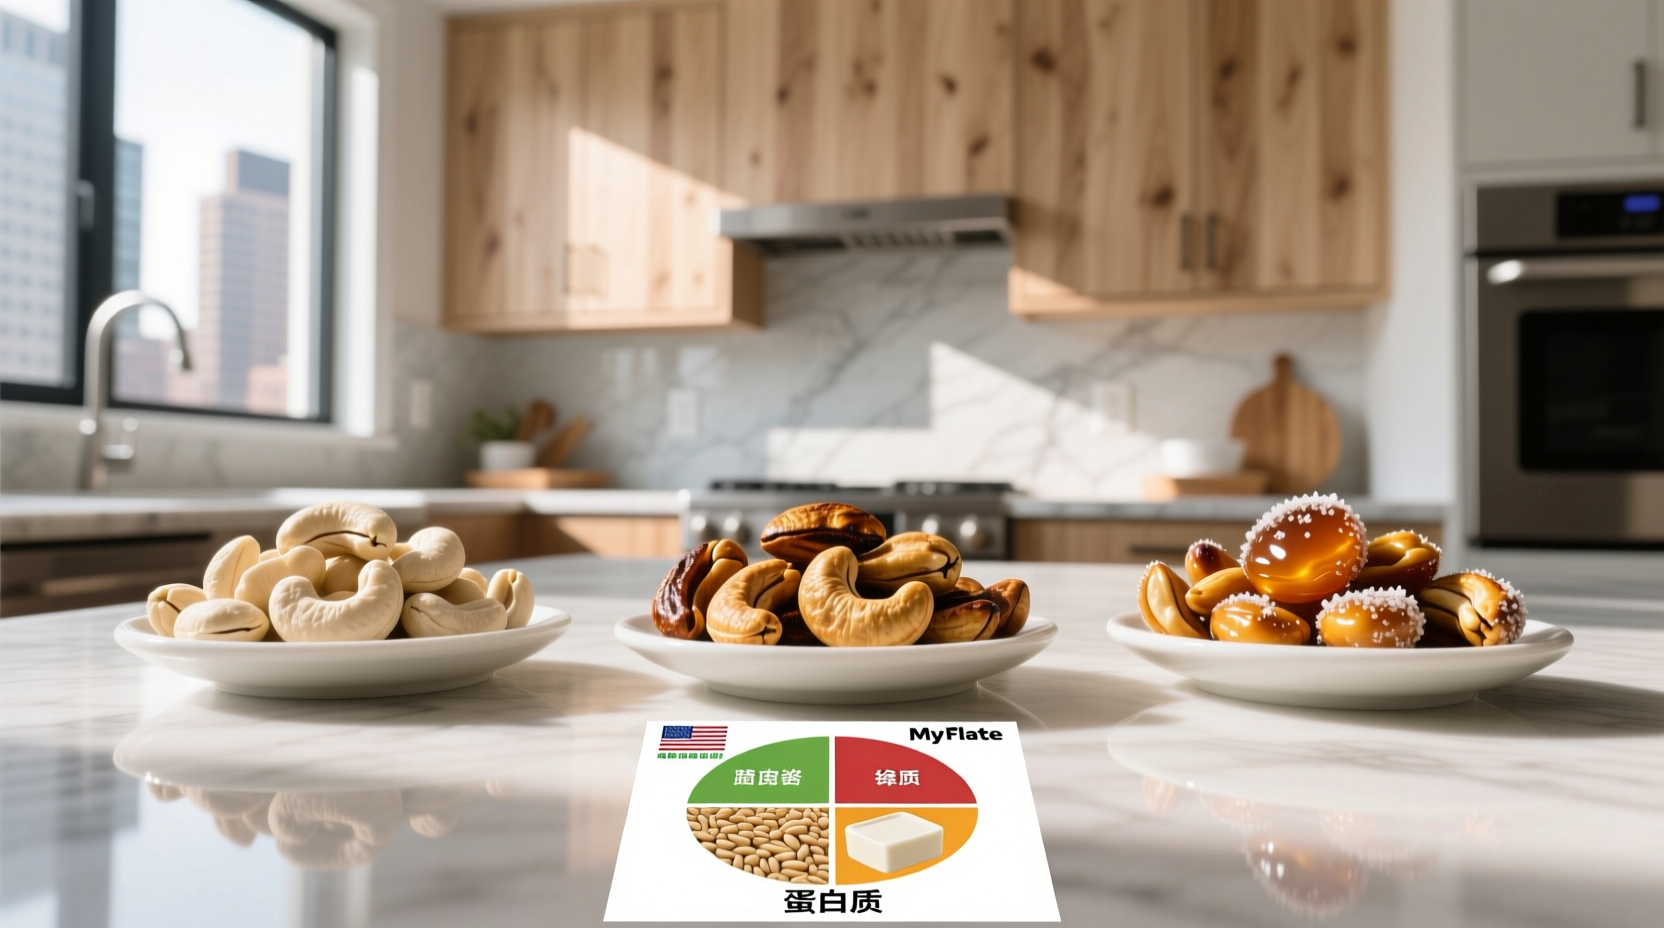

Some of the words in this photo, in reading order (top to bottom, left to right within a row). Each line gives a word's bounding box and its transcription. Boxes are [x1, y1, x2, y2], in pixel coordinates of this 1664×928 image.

[909, 726, 1003, 744] MyFlate
[784, 889, 882, 914] 蛋白质
